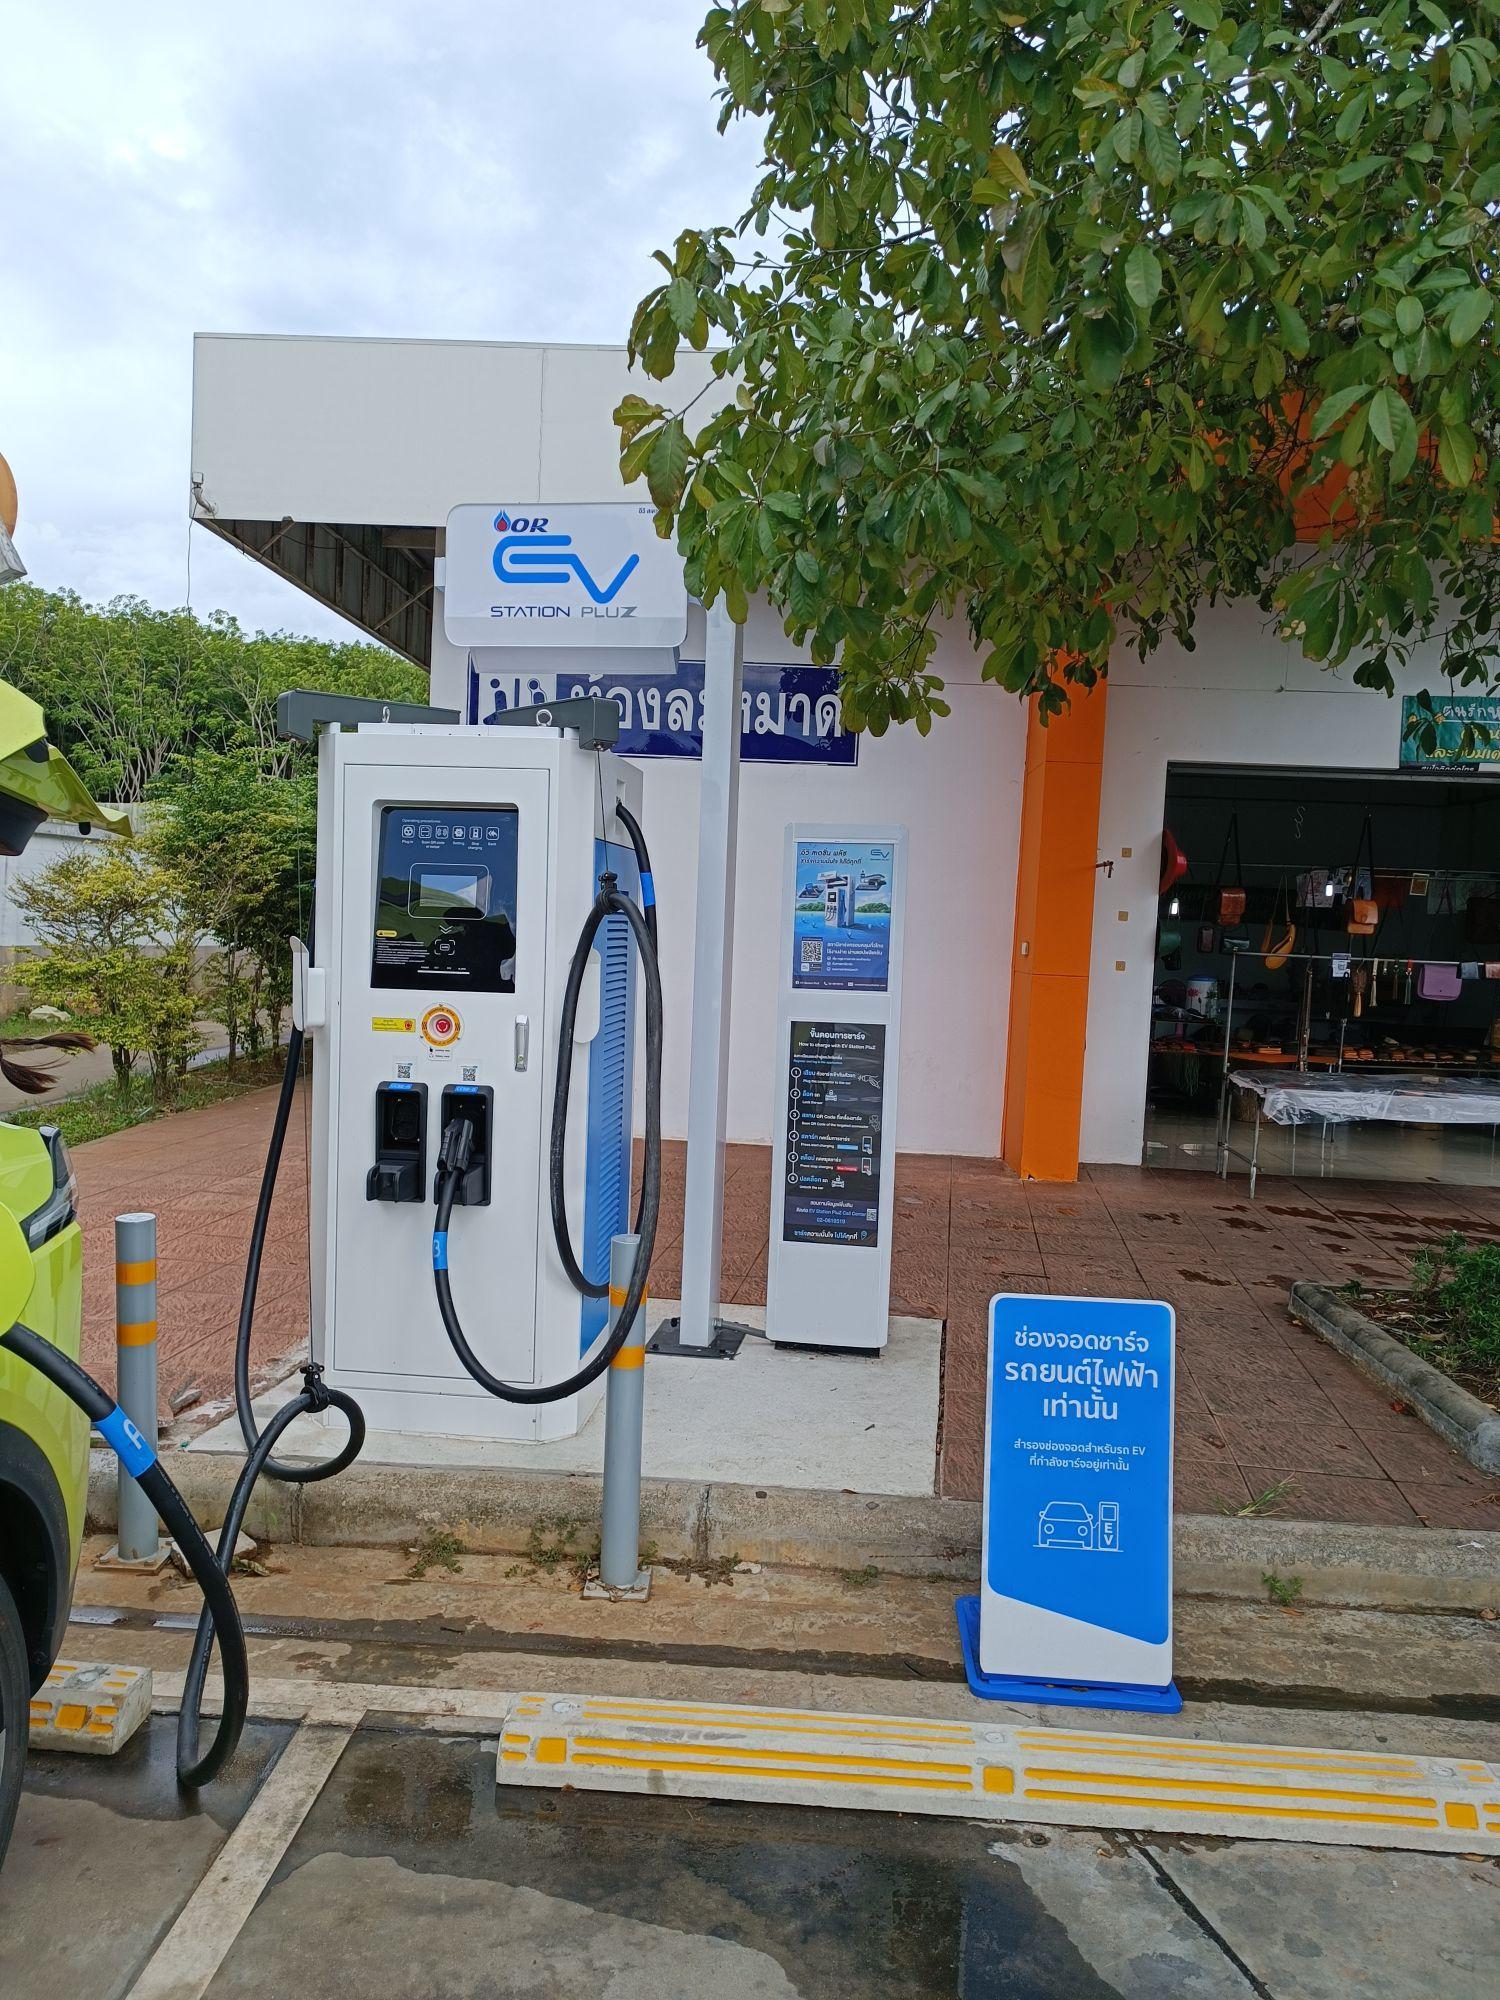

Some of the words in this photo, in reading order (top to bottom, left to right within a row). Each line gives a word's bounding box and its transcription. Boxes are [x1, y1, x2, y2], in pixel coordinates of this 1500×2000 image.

[510, 517, 549, 533] OR
[492, 534, 640, 604] EV
[490, 606, 570, 618] STATION
[581, 606, 638, 618] PLUZ
[1014, 1325, 1149, 1353] ช่องจอดชาร์จ
[1005, 1358, 1159, 1388] รถยนต์ไฟฟ้า
[1043, 1386, 1118, 1420] เท่านั้น
[1014, 1438, 1129, 1455] สำรองช่องจอดสำหรับรถ
[1132, 1446, 1146, 1455] EV
[1029, 1452, 1130, 1472] ที่กำลังชาร์จอยู่เท่านั้น
